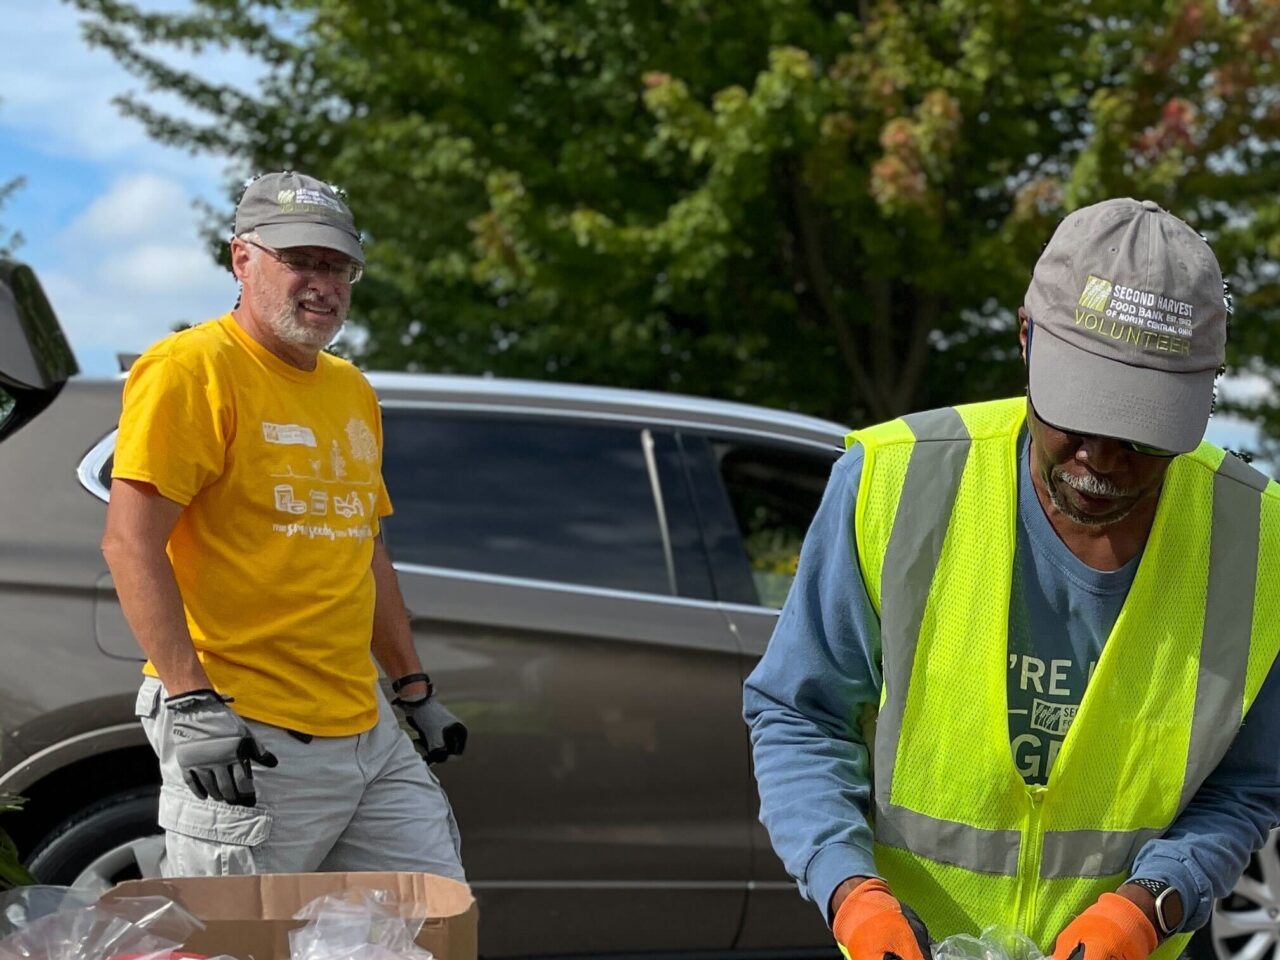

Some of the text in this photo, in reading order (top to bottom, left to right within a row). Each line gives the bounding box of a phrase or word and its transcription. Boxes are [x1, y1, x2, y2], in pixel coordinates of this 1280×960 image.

[1110, 299, 1136, 314] FOOD
[1138, 307, 1163, 322] BANK
[1113, 284, 1193, 317] SECOND HARVEST
[1075, 308, 1191, 356] VOLUNTEER
[1105, 309, 1118, 318] OF
[1119, 312, 1144, 325] NORTH
[1146, 320, 1177, 334] CENTRAL
